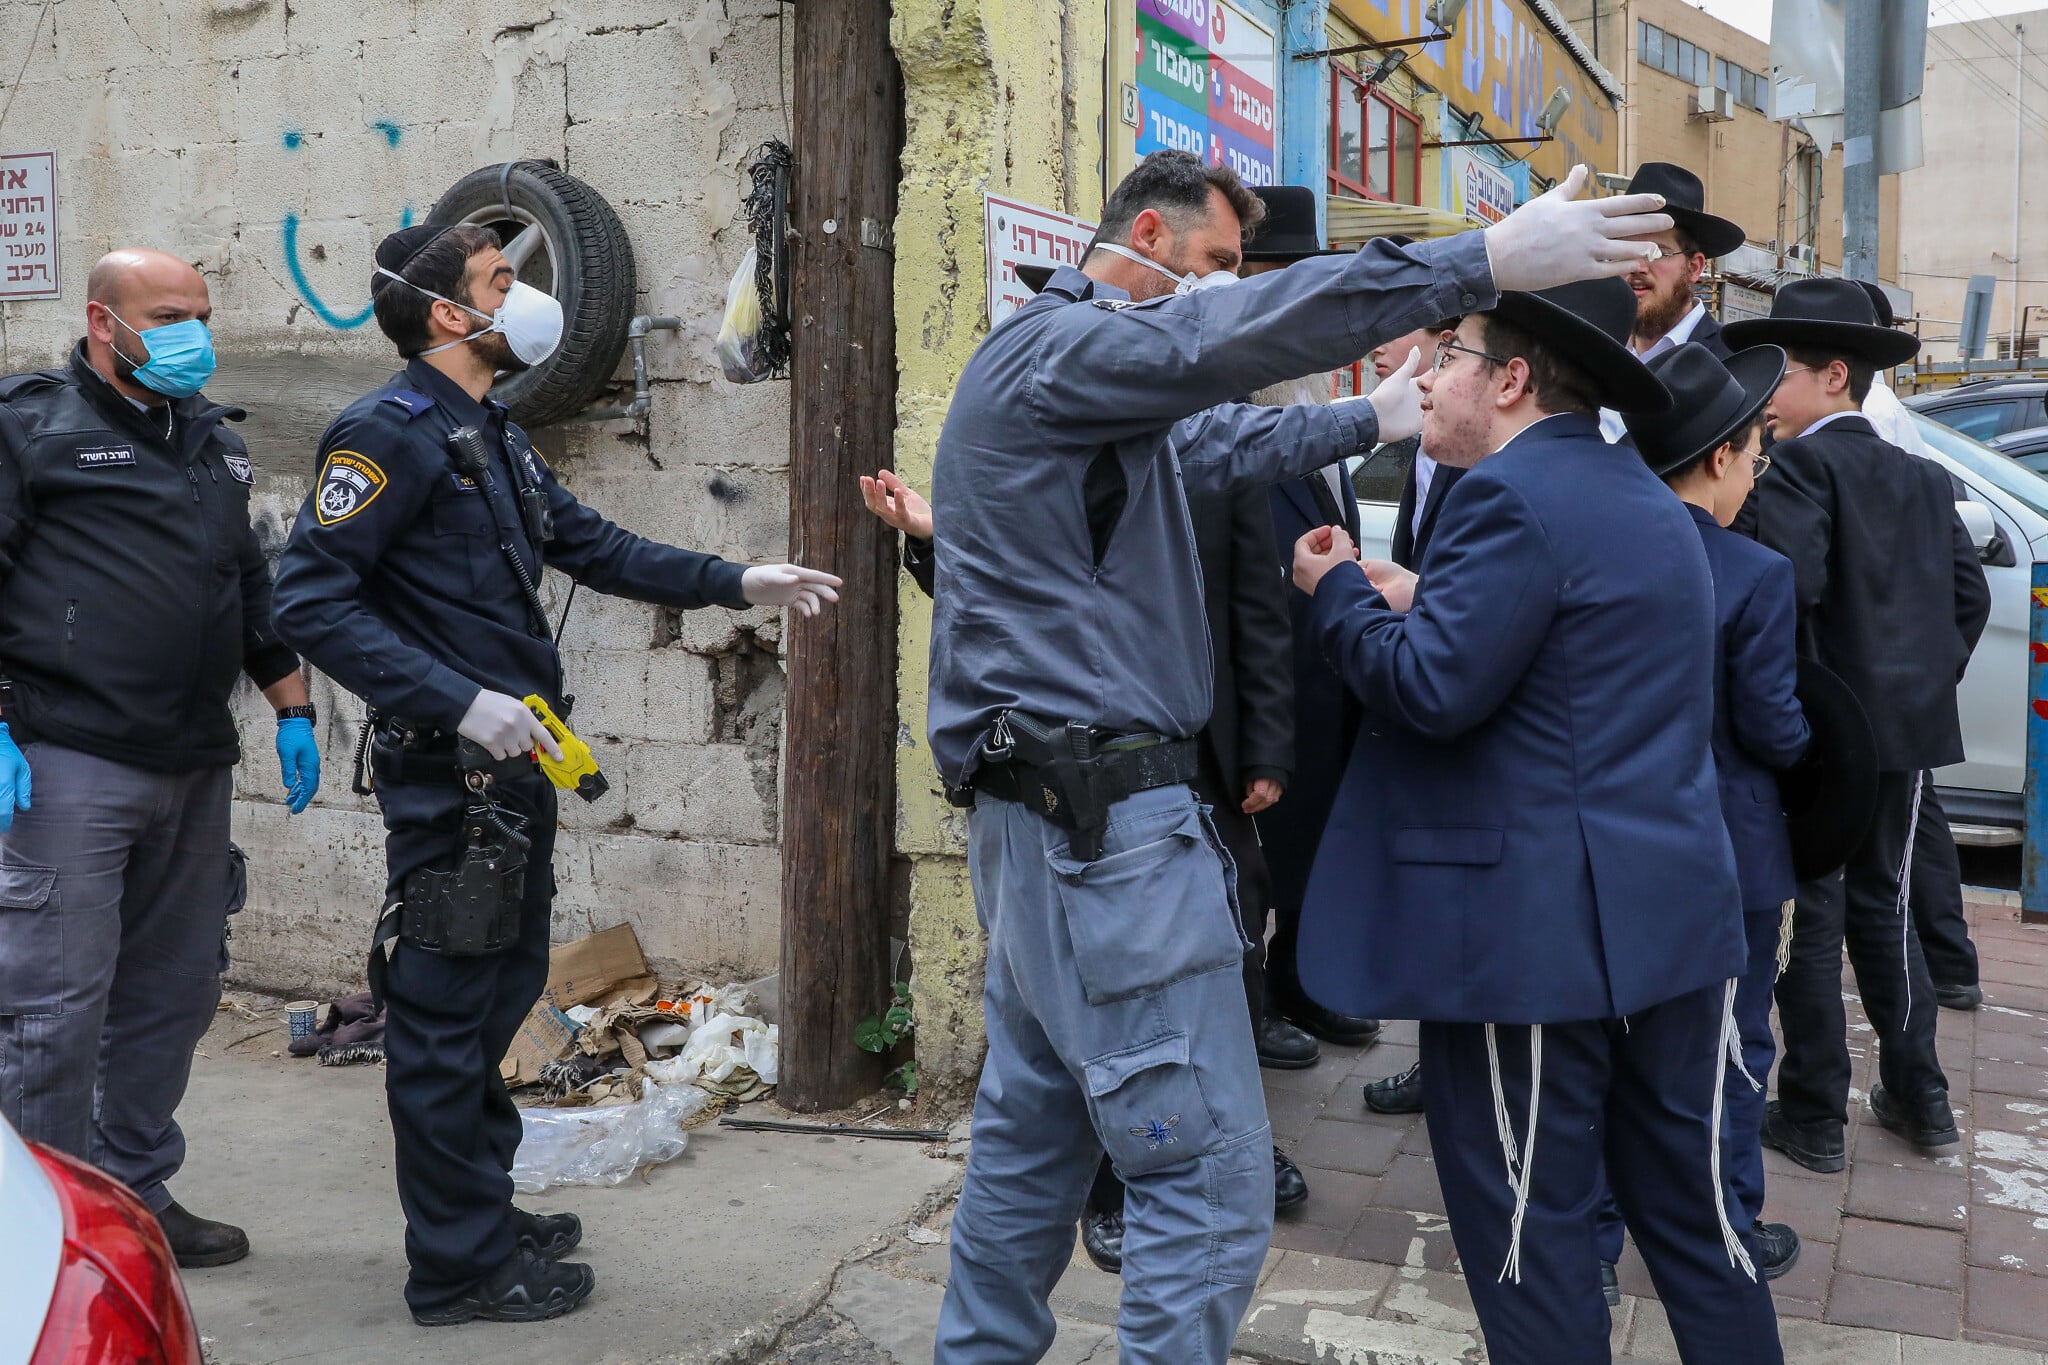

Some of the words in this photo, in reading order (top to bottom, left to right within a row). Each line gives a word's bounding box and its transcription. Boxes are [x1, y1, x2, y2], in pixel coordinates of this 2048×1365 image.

[1151, 39, 1205, 94] טמבור
[1127, 90, 1134, 119] 3
[1230, 83, 1273, 132] טמבור
[1151, 110, 1204, 157] טמבור
[25, 221, 46, 236] 24
[1012, 223, 1087, 266] זהרה!
[5, 242, 46, 258] מעבר
[7, 263, 47, 281] רכב
